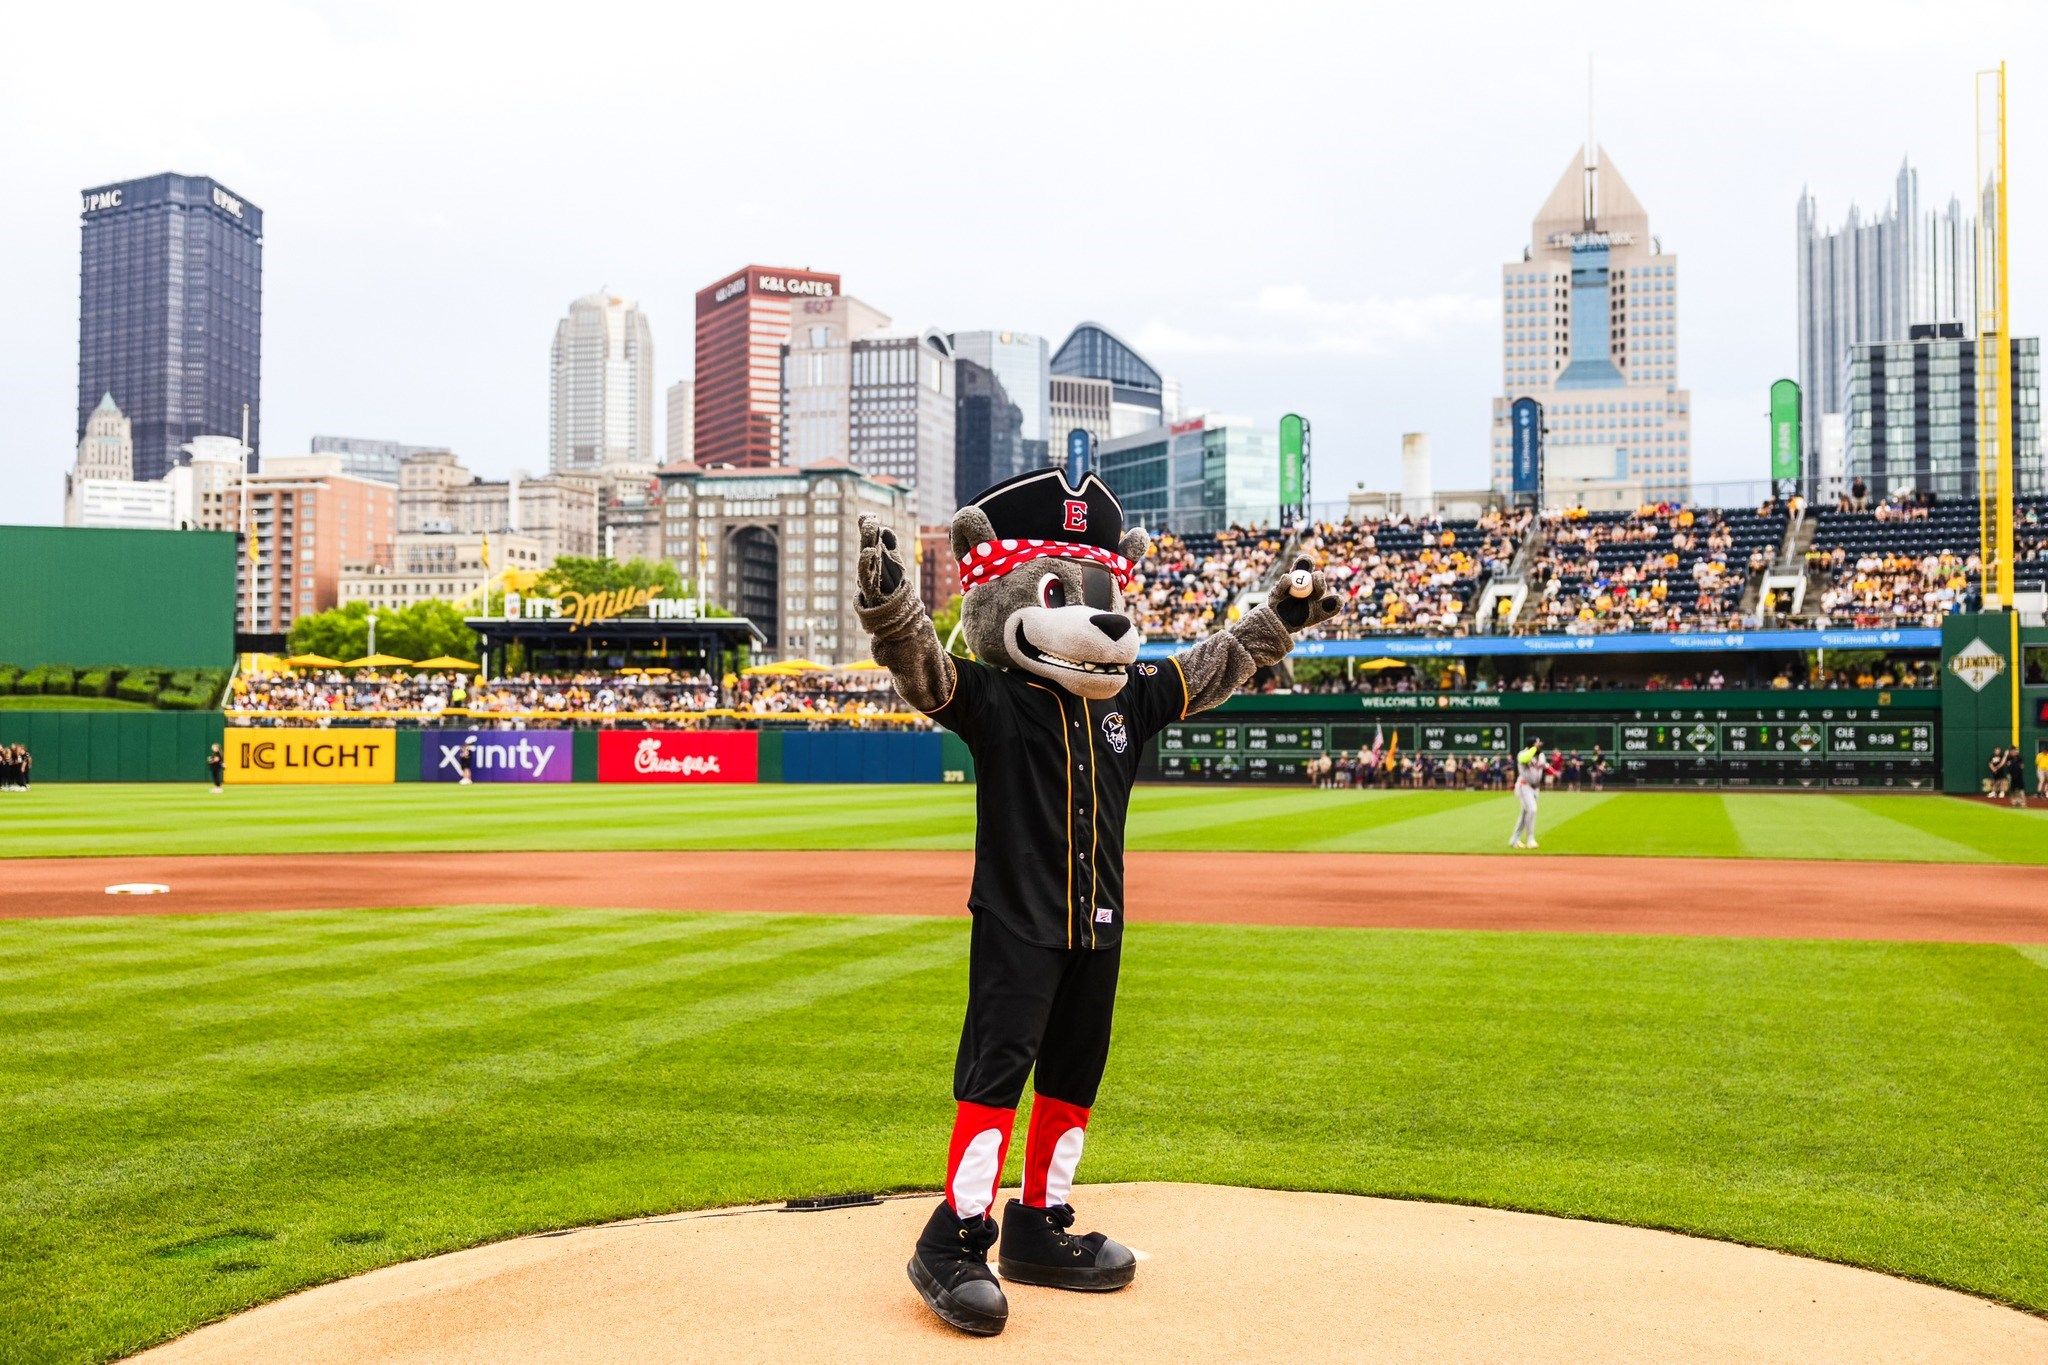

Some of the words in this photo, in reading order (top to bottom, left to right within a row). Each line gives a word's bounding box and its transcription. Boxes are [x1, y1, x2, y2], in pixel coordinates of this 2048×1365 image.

[213, 187, 244, 219] UPMC
[759, 275, 787, 292] K&L
[787, 279, 833, 297] GATES
[1063, 499, 1088, 532] E
[525, 598, 562, 618] IT'S
[561, 585, 665, 632] Miller
[649, 598, 698, 619] TIME
[1361, 696, 1417, 707] WELCOME
[1420, 696, 1436, 707] TO
[1449, 696, 1471, 707] PNC
[1473, 696, 1501, 707] PARK
[241, 742, 275, 769] IC
[286, 744, 380, 768] LIGHT
